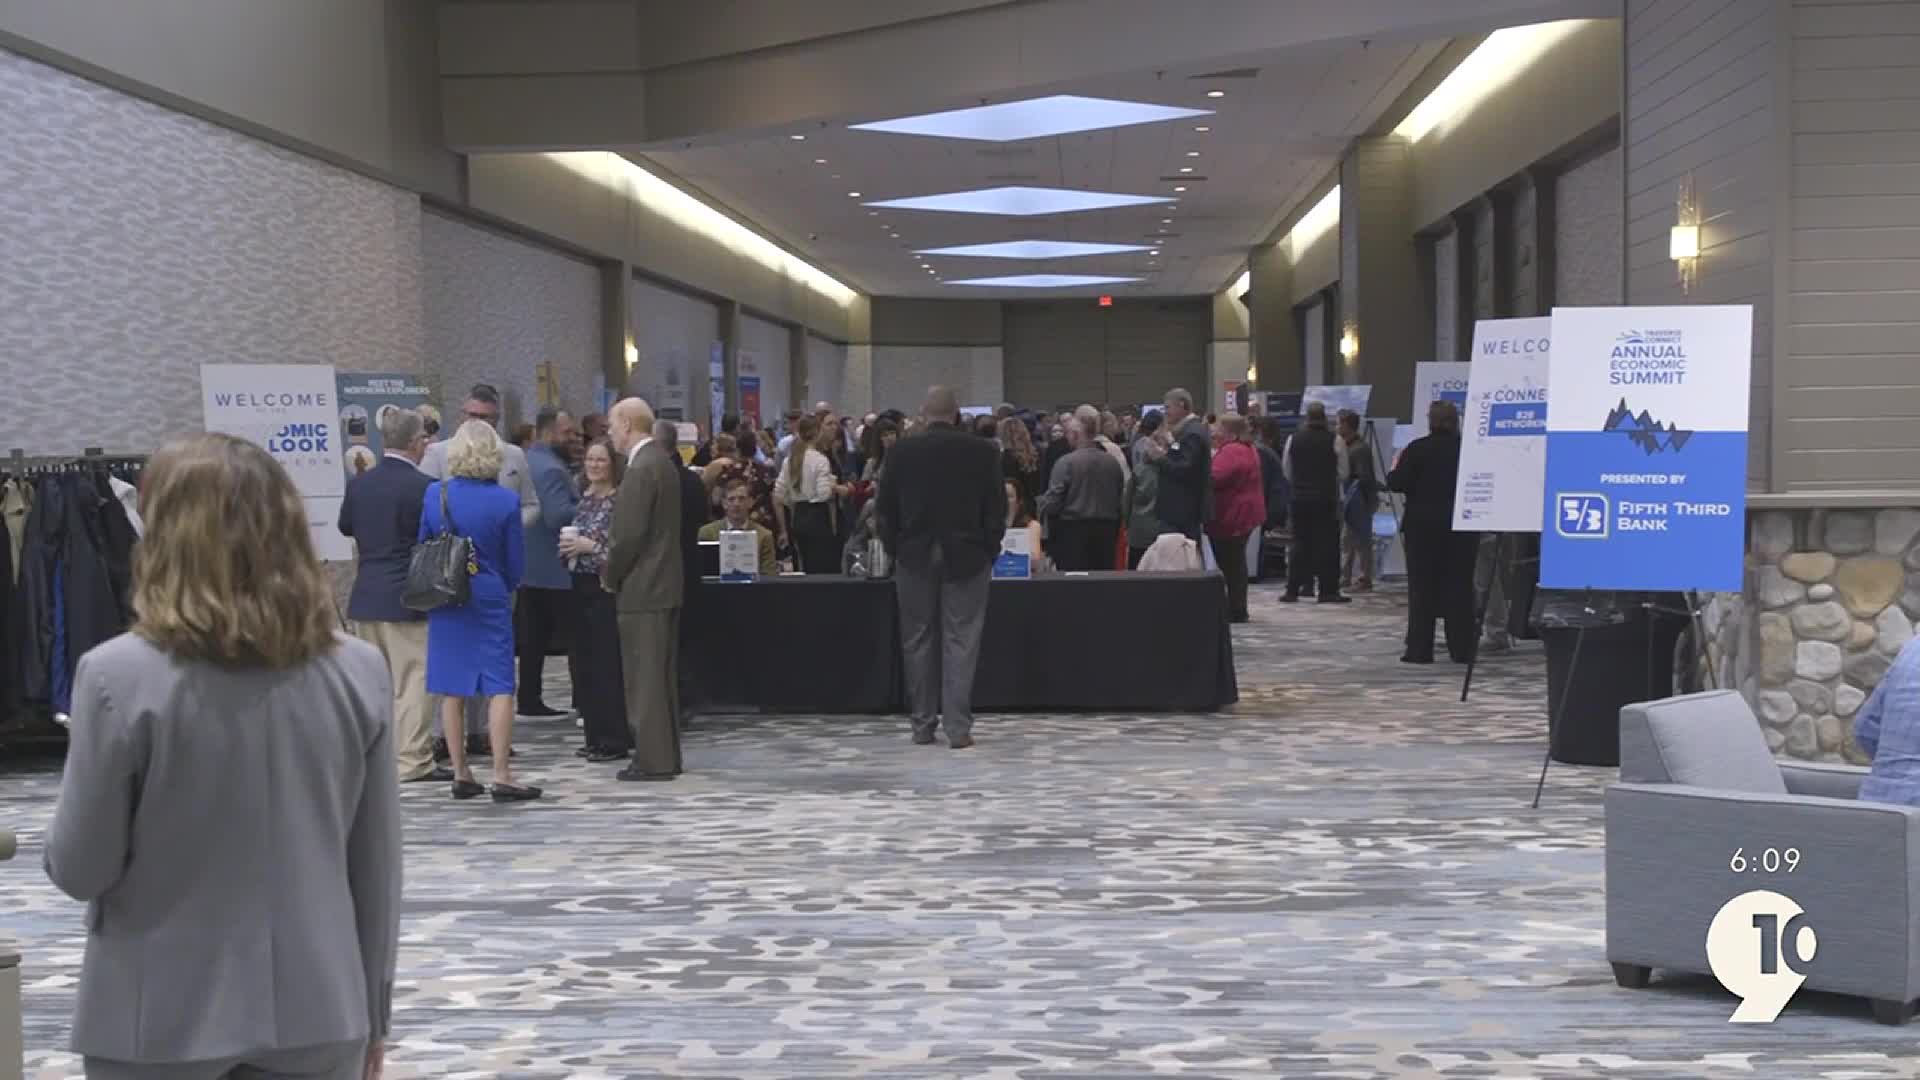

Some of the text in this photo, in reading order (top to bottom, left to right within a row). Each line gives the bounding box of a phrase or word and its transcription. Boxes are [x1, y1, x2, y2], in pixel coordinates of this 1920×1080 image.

[1483, 338, 1550, 355] WELCO
[1611, 345, 1686, 358] ANNUAL
[1610, 359, 1686, 370] ECONOMIC
[1610, 371, 1685, 384] SUMMIT
[215, 392, 328, 407] WELCOME
[1494, 388, 1547, 402] CONNE
[268, 439, 329, 452] LOOK
[1600, 474, 1687, 485] PRESENTED BY
